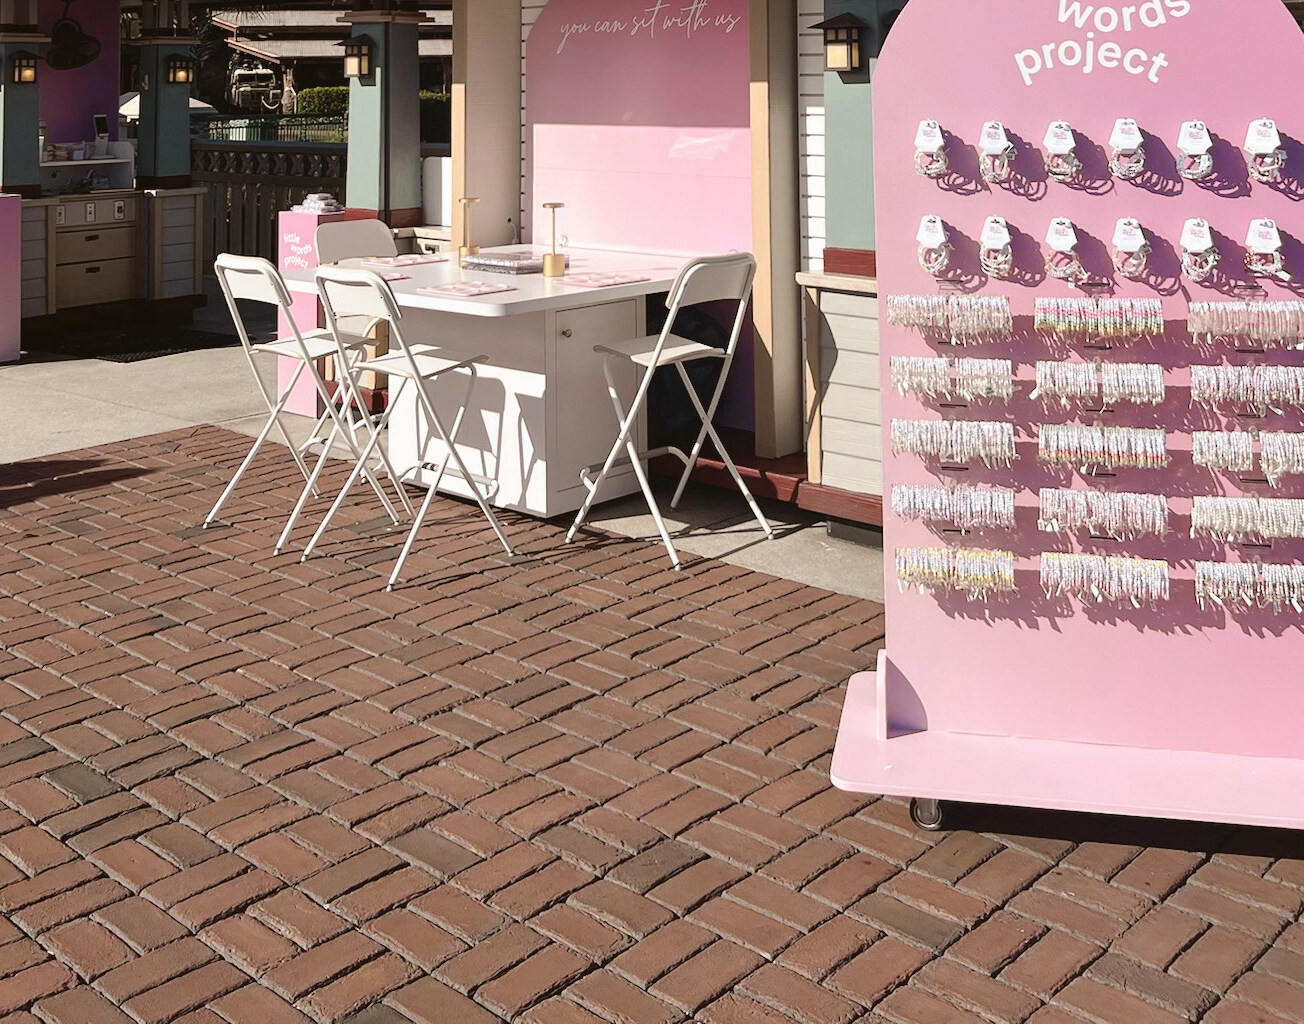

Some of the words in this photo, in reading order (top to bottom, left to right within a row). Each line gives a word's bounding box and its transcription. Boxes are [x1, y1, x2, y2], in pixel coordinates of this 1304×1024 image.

[556, 22, 591, 55] you
[594, 19, 628, 34] can
[714, 11, 742, 33] us
[1014, 32, 1169, 86] project
[283, 232, 301, 244] little
[290, 243, 313, 255] words
[284, 255, 308, 270] project
